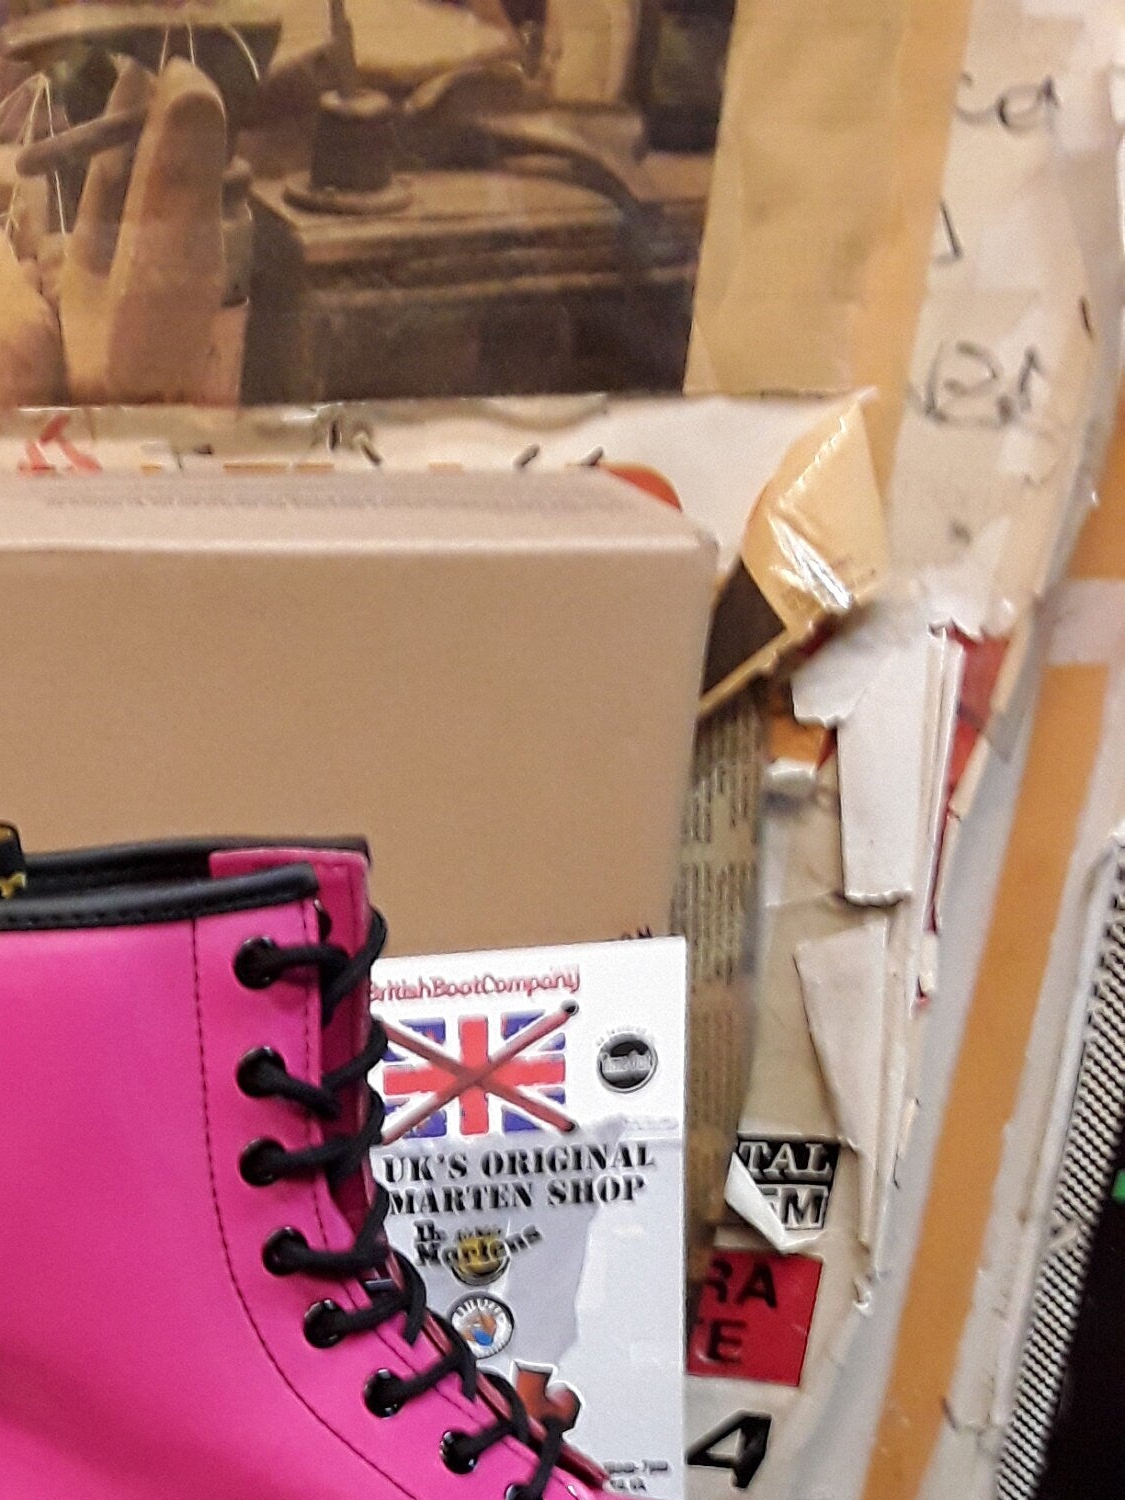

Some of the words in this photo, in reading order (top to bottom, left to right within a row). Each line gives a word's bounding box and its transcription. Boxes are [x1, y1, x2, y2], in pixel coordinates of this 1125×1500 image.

[383, 1152, 468, 1183] UK'S
[481, 1143, 655, 1177] ORIGINAL
[389, 1183, 533, 1215] MARTEN
[547, 1175, 645, 1206] SHOP
